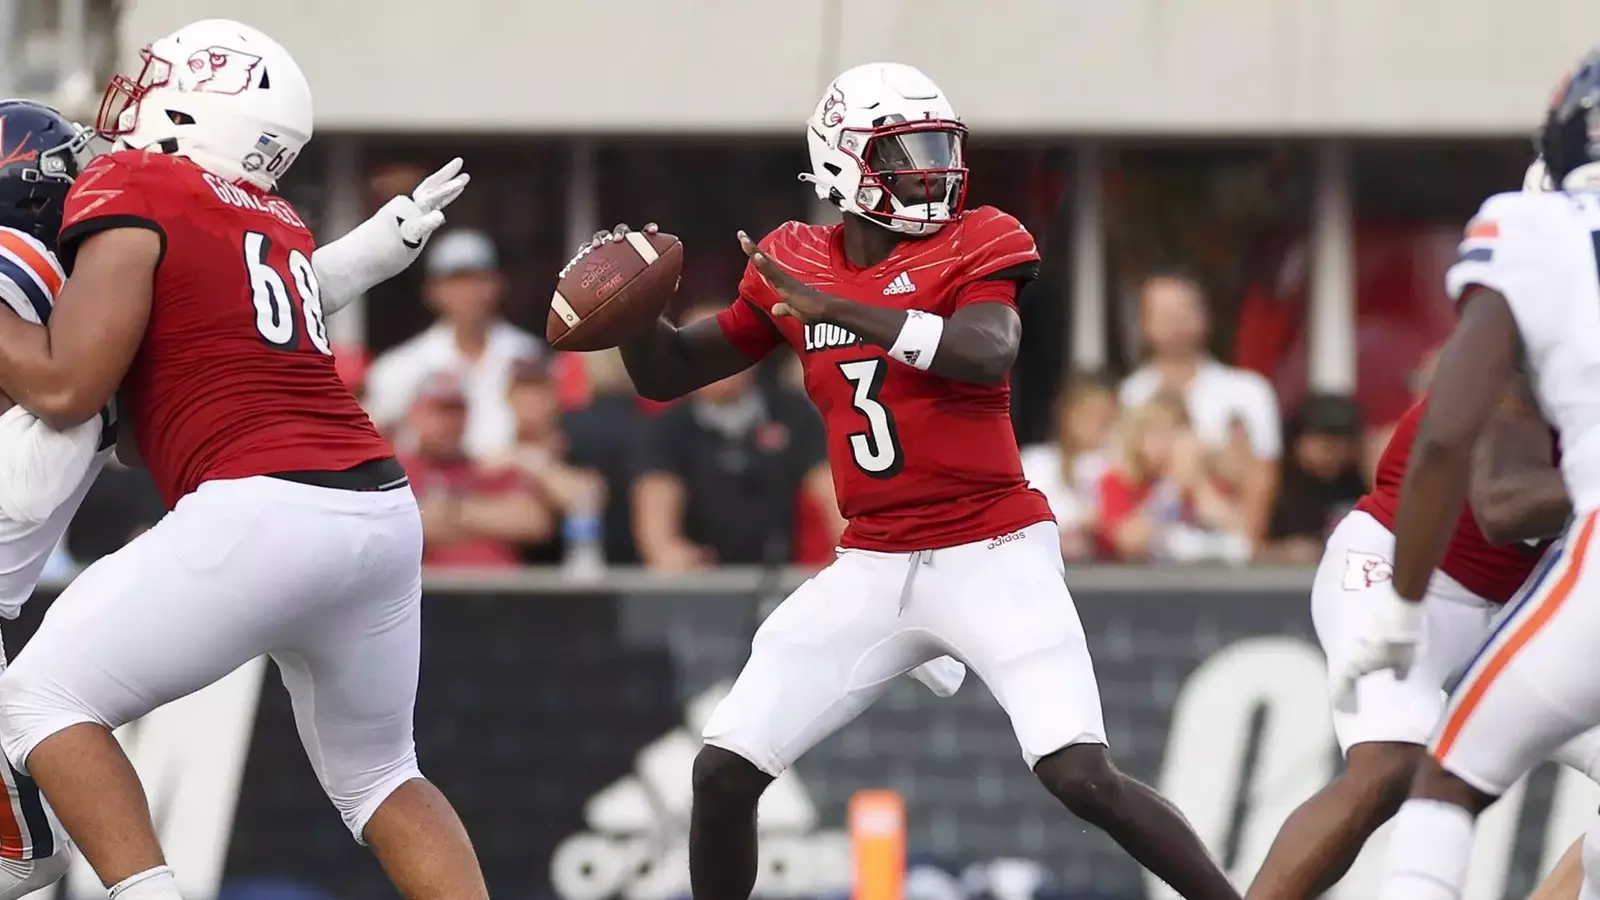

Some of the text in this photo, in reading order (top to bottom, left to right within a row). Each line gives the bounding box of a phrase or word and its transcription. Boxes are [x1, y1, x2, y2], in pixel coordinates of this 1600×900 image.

[244, 229, 333, 356] 68
[882, 283, 916, 297] adidas
[837, 357, 900, 478] 3
[987, 531, 1026, 550] adidas
